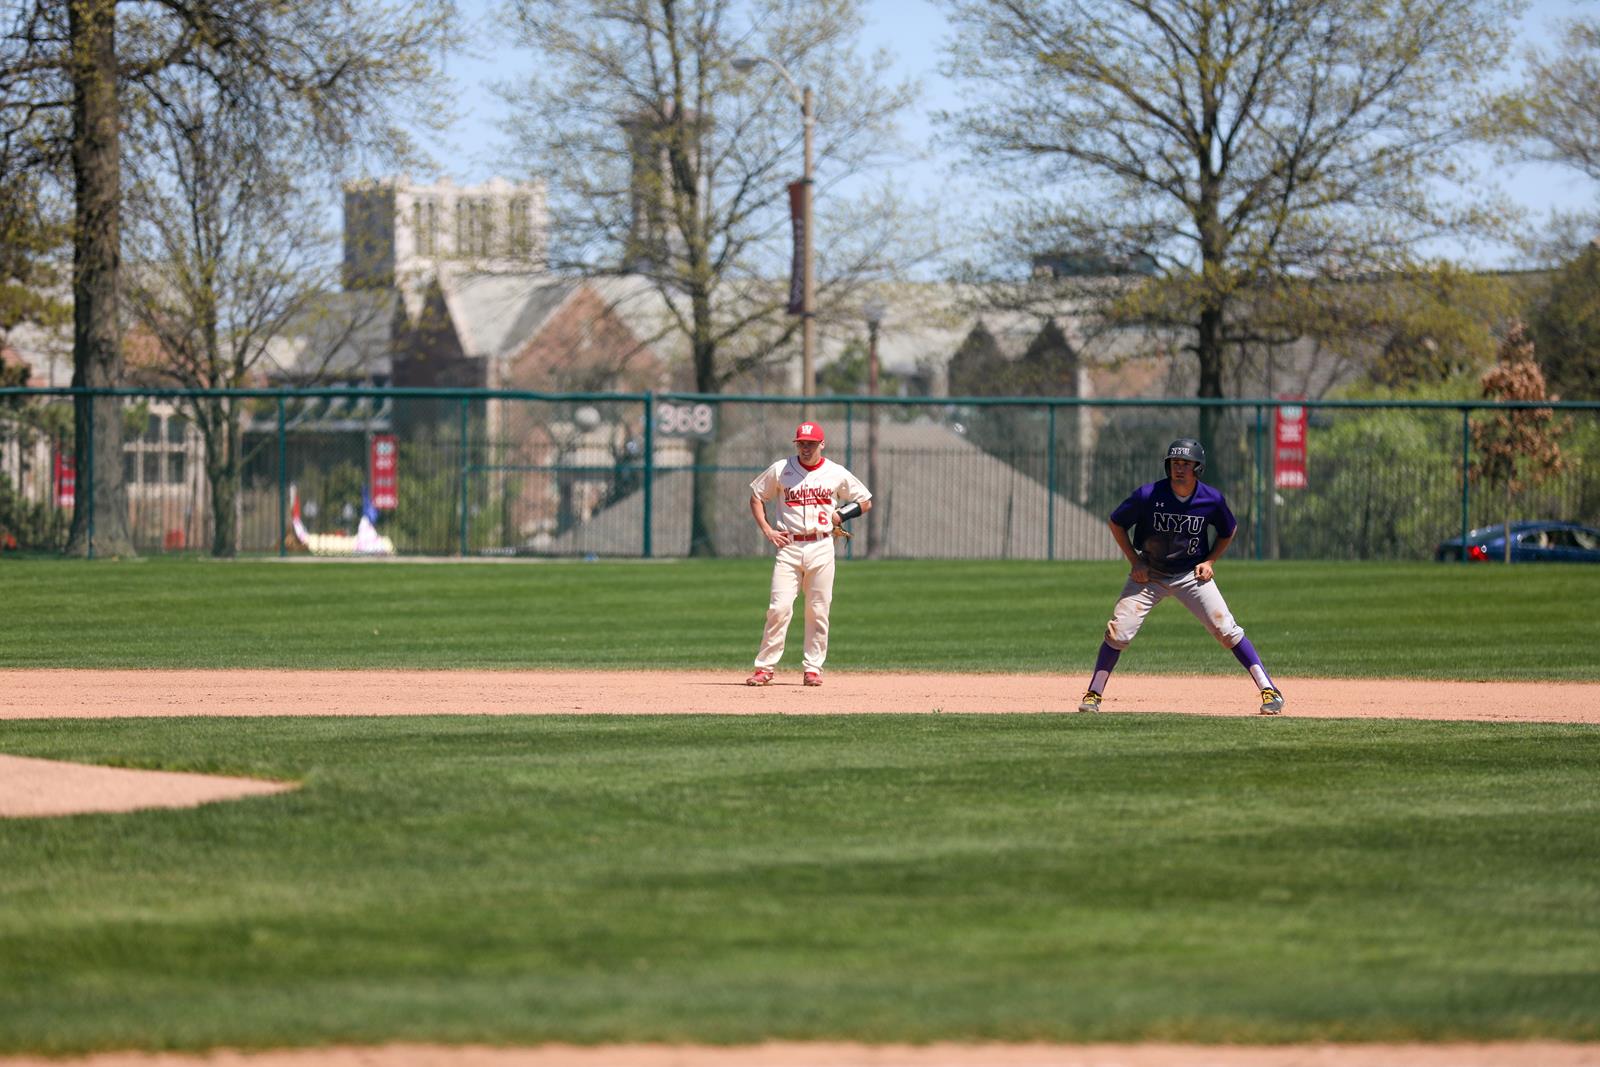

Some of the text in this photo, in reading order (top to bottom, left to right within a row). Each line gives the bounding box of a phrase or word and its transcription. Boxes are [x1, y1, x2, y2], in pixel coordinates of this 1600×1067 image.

[658, 403, 712, 433] 368
[802, 425, 813, 434] W
[1171, 447, 1190, 455] NYU
[784, 484, 833, 501] Washington
[818, 511, 828, 525] 6
[1153, 512, 1204, 534] NYU
